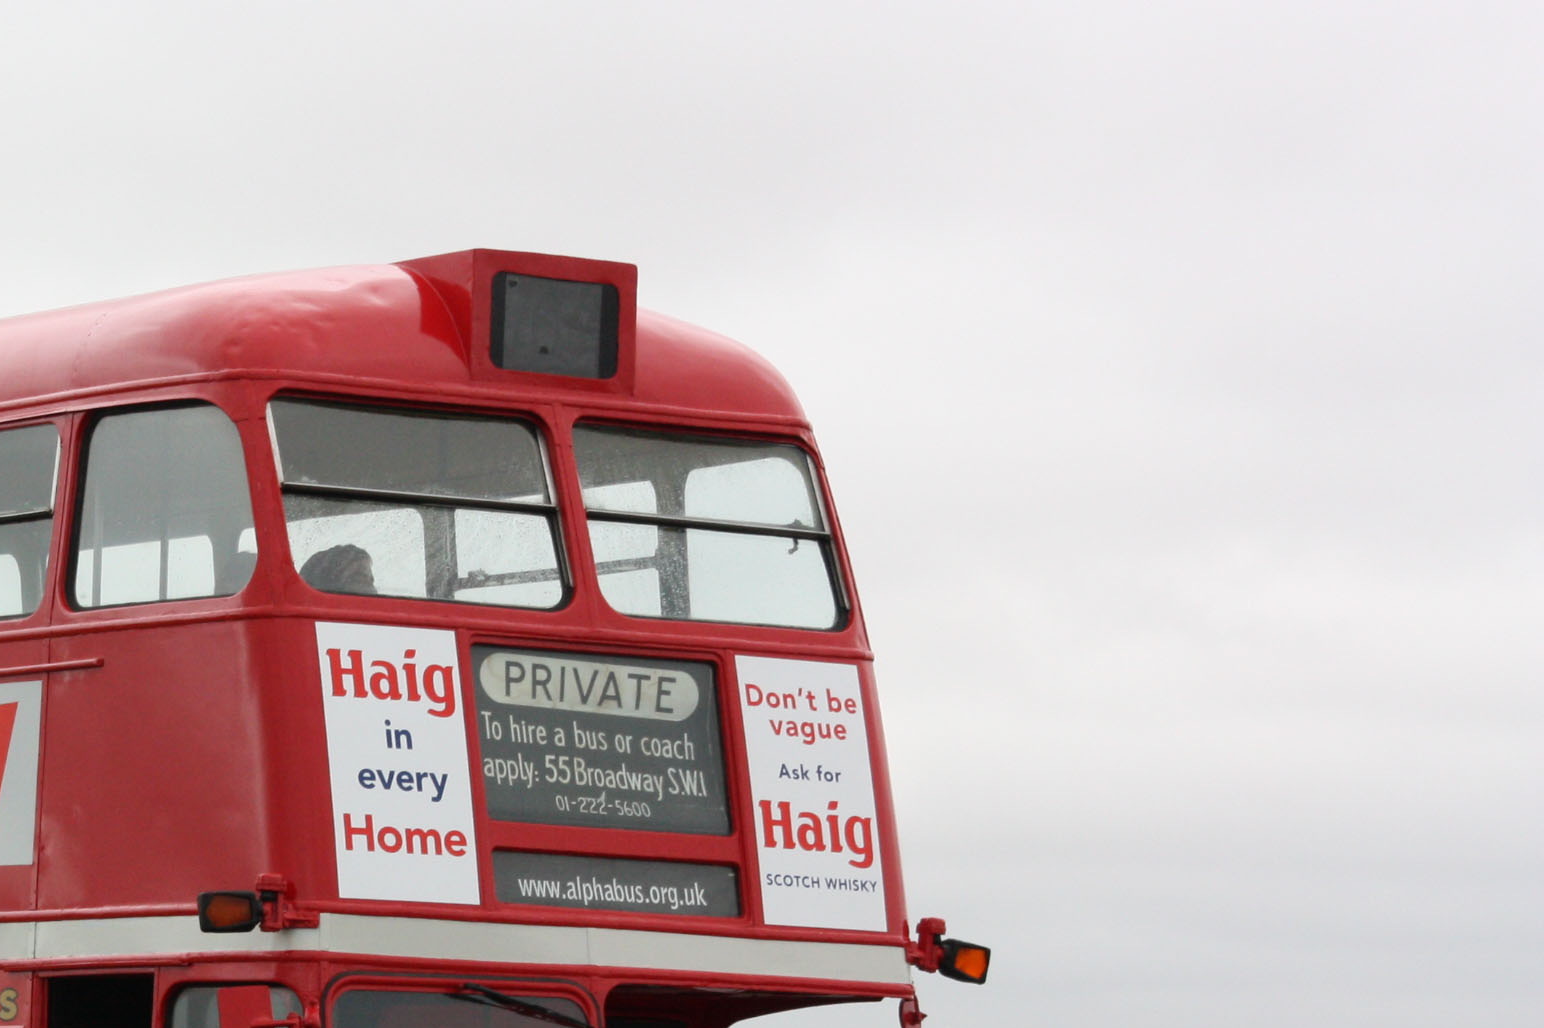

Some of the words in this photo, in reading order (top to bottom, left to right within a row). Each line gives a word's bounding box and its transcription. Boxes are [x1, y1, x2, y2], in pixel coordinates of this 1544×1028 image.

[326, 648, 456, 718] Haig
[504, 660, 677, 714] PRIVATE
[744, 683, 817, 711] Don't
[826, 688, 857, 714] be
[384, 719, 413, 750] in
[481, 711, 502, 741] To
[509, 715, 547, 745] hire
[554, 726, 566, 747] a
[573, 720, 607, 751] bus
[614, 733, 633, 754] or
[640, 733, 695, 760] coach
[769, 719, 847, 745] vague
[358, 768, 448, 803] every
[483, 753, 539, 788] apply:
[545, 754, 571, 783] 55
[573, 758, 664, 801] Broadway
[778, 763, 810, 781] Ask
[816, 764, 842, 783] for
[555, 793, 651, 818] 01-222-5600
[343, 813, 468, 857] Home
[758, 800, 874, 869] Haig
[518, 875, 707, 910] www.alphabus.org.uk
[766, 873, 820, 889] SCOTCH
[825, 877, 877, 893] WHISKY
